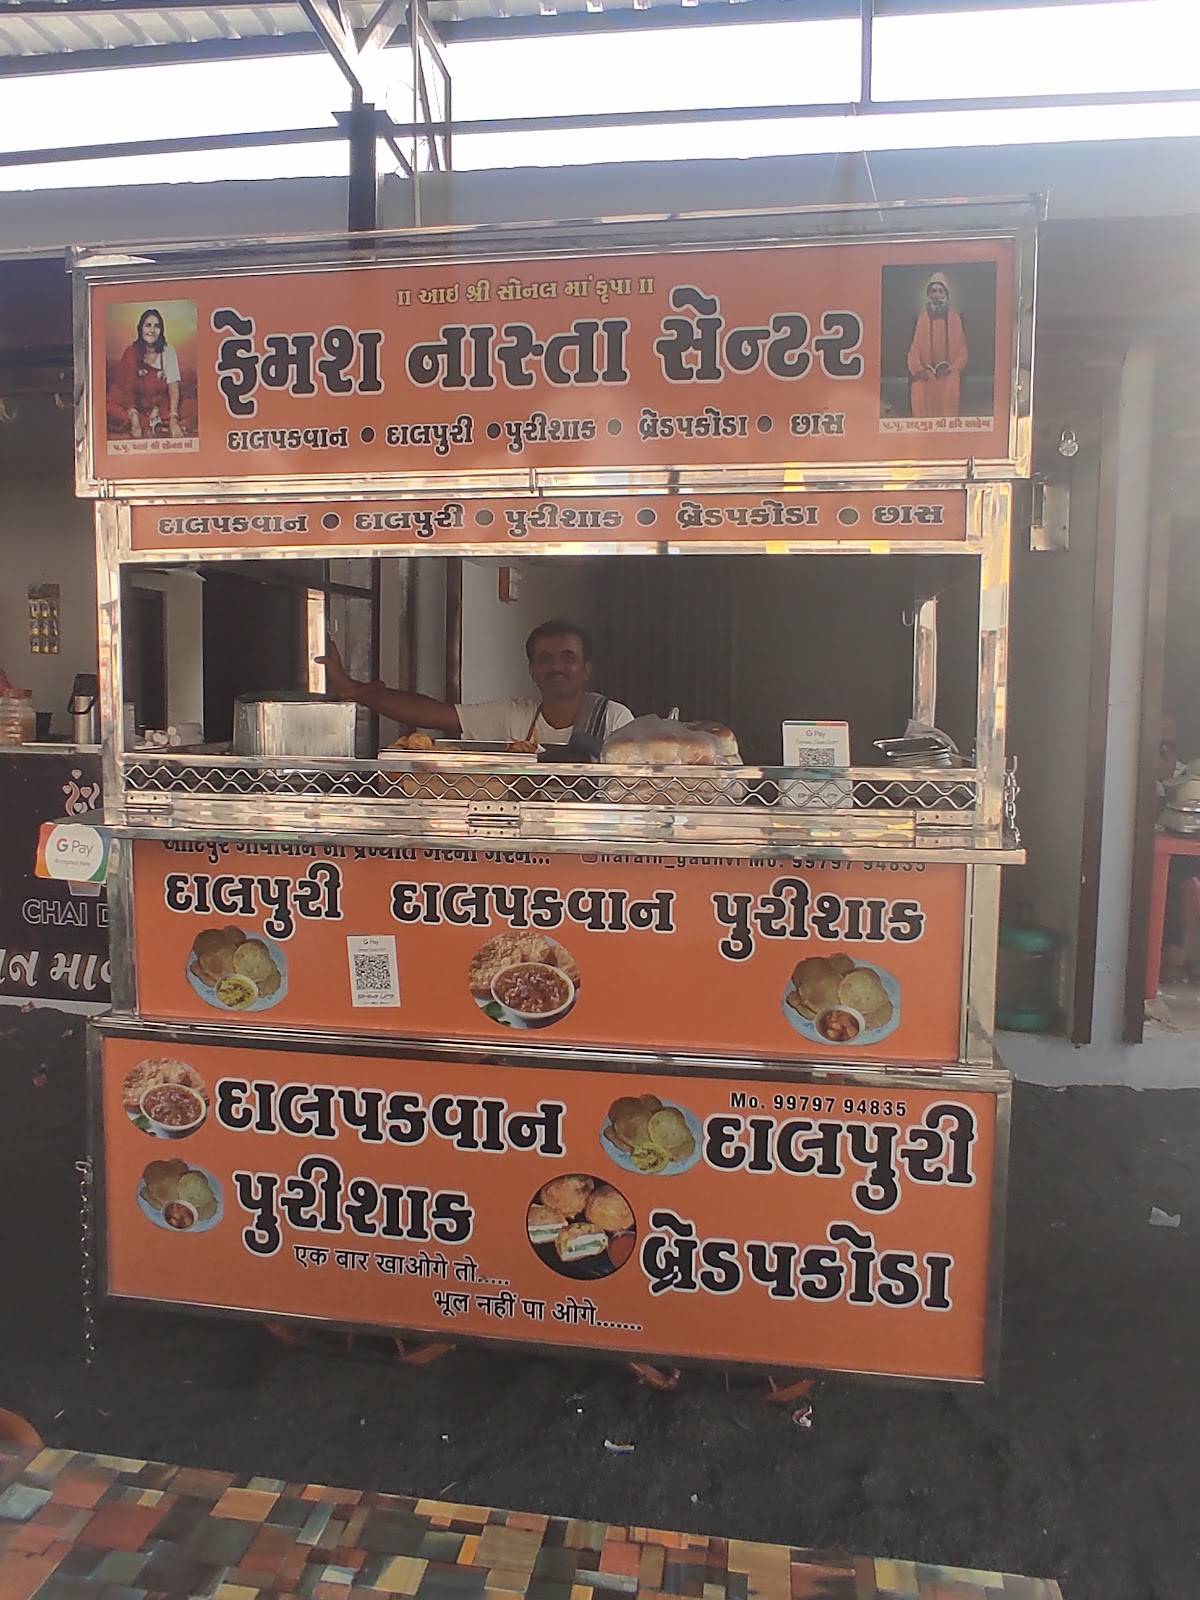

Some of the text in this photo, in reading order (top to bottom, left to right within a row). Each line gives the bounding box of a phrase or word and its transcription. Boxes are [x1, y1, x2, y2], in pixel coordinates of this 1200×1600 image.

[466, 279, 491, 303] શ્રી
[497, 277, 558, 301] સોનલ
[405, 317, 631, 393] નાસ્તા
[653, 284, 866, 384] સેન્ટર
[226, 407, 846, 457] દાલપકવાન દાલપુરી પુરીશાક બ્રેડપકોડા છાસ
[157, 499, 944, 539] દાલપકવાન દાલપુરી પુરીશાક બ્રેડપકોડા છાસ
[71, 839, 93, 857] Pay
[22, 898, 88, 927] CHAI
[164, 859, 926, 963] દાલપુરી દાલપકવાન પુરીશાક
[214, 1076, 568, 1158] દાલપકવાન
[730, 1092, 907, 1117] Mo. 99797 94835
[702, 1100, 978, 1214] દાલપુરી
[231, 1152, 476, 1257] પુરીશાક
[293, 1244, 329, 1269] एक
[334, 1249, 370, 1272] बार
[374, 1250, 449, 1280] खाओगे
[638, 1207, 956, 1313] બ્રેડપકોડા
[433, 1290, 470, 1317] भूल
[476, 1290, 518, 1319] नहीं
[521, 1298, 546, 1321] पा
